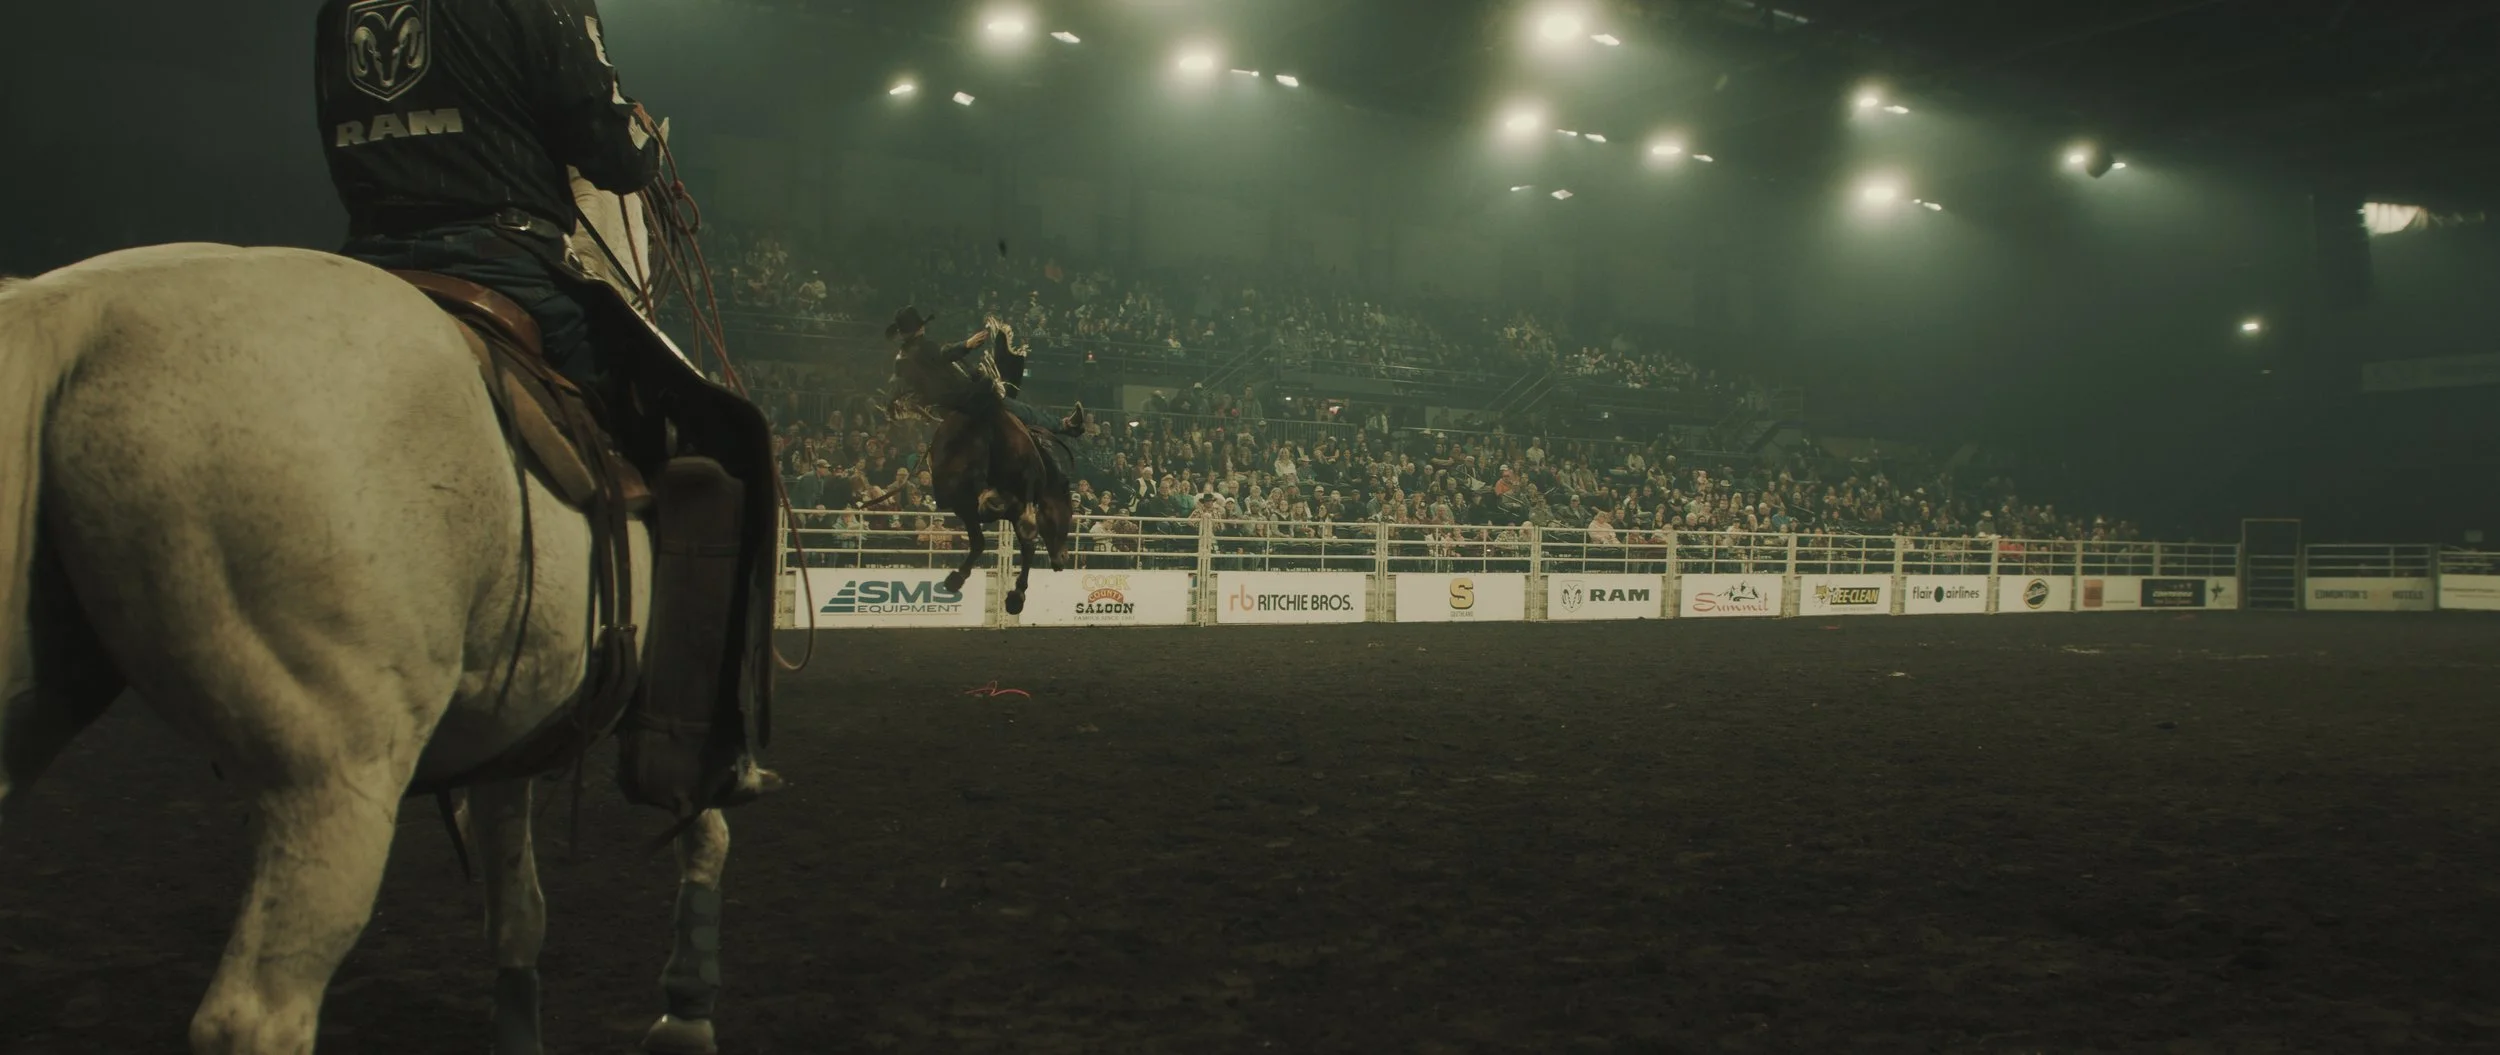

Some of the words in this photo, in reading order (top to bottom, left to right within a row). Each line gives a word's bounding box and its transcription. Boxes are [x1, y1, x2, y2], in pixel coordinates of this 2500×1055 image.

[336, 108, 463, 148] RAM
[858, 580, 963, 604] SMS
[1088, 589, 1124, 602] COUNTY
[1449, 577, 1474, 610] S
[1590, 588, 1650, 602] RAM
[1831, 588, 1879, 604] BEE-CLEAN
[1912, 586, 1933, 600] flair
[1946, 586, 1980, 600] airlines
[857, 604, 962, 614] EQUIPMENT
[1075, 602, 1135, 614] SALOON
[1258, 594, 1308, 611] RITCHIE
[1311, 594, 1354, 611] BROS.
[1693, 592, 1769, 612] Summit
